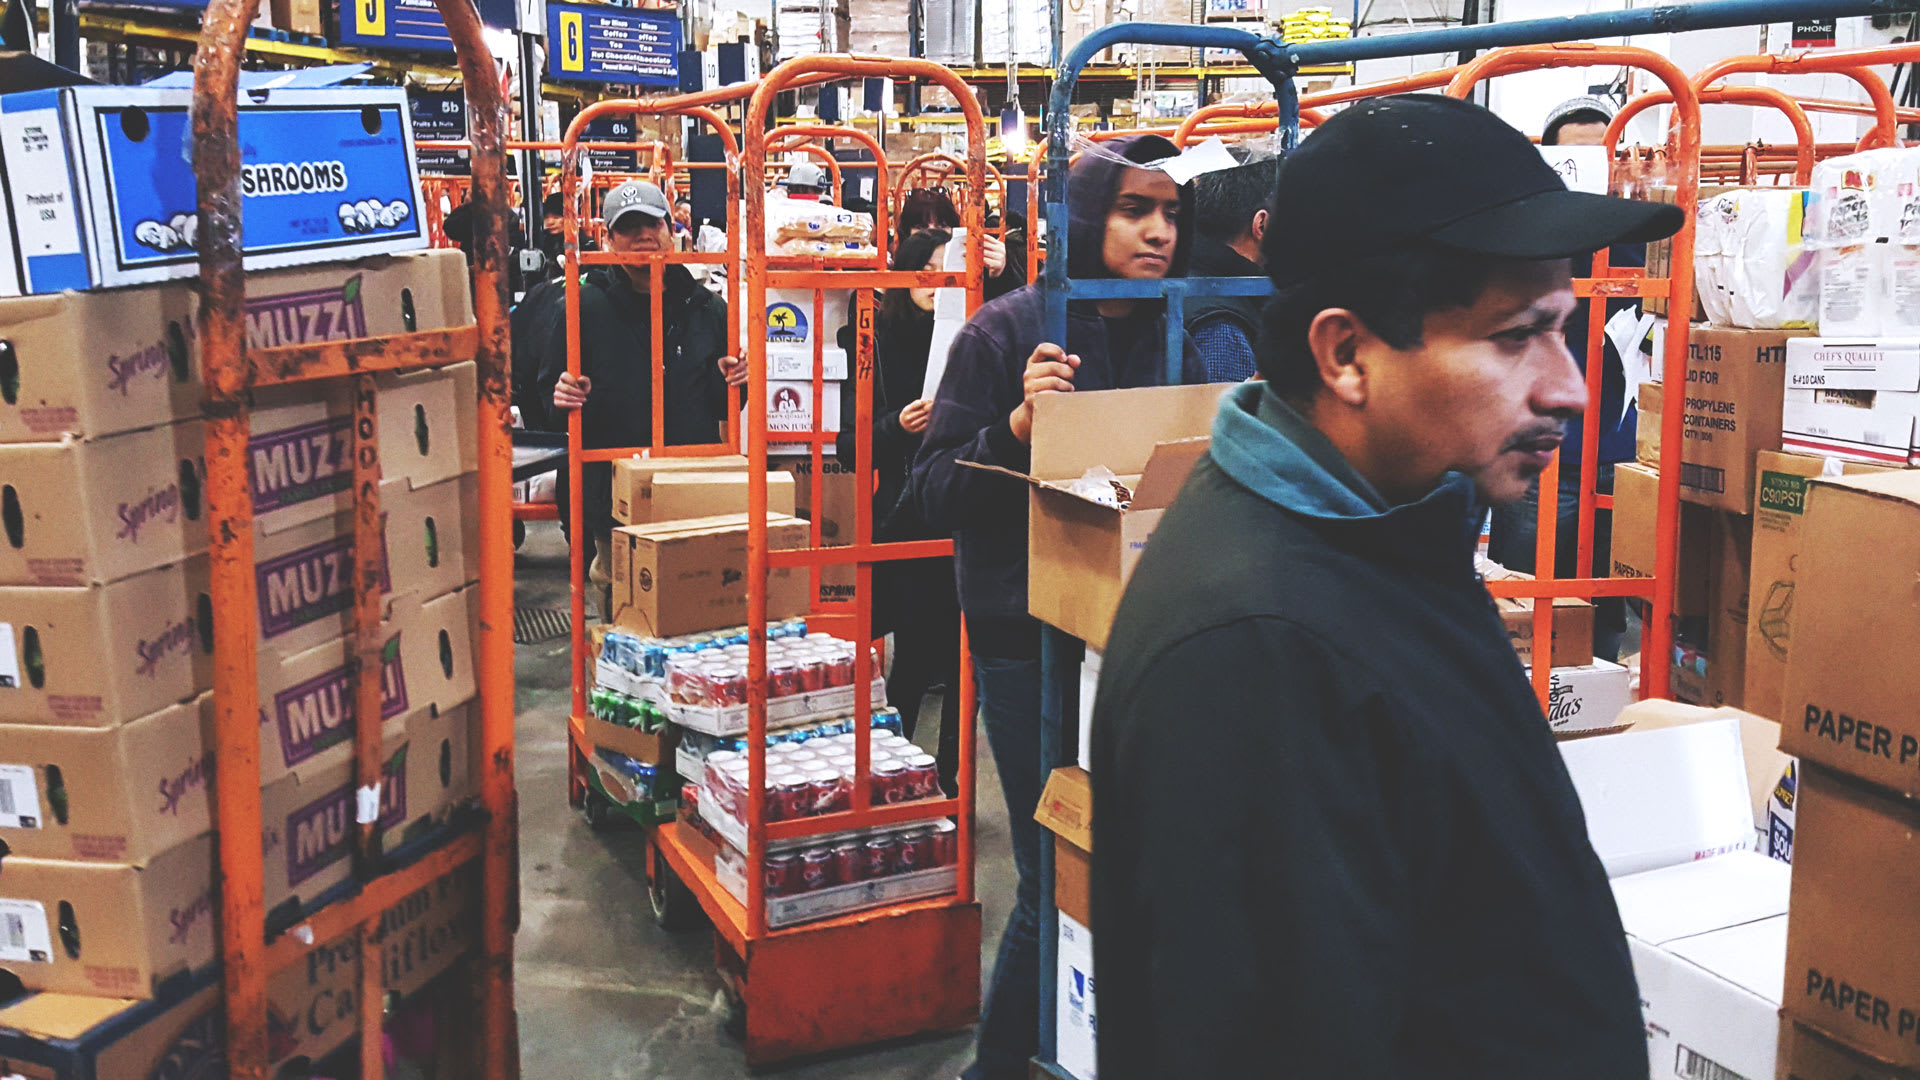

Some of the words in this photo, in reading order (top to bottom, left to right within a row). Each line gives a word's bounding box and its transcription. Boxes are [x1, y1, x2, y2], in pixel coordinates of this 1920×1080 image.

[603, 29, 628, 39] Coffee
[1797, 25, 1833, 33] PHONE
[568, 21, 578, 62] 6
[609, 41, 623, 49] Tea
[708, 63, 716, 79] 10
[612, 123, 628, 134] 6b
[242, 164, 344, 193] SHROOMS
[39, 208, 56, 221] USA
[246, 301, 356, 349] MUZZI
[1814, 352, 1842, 361] CHEF'S
[1845, 351, 1884, 365] QUALITY
[1700, 371, 1718, 384] FOR
[1810, 375, 1825, 385] CANS
[1686, 398, 1735, 415] PROPYLENE
[769, 423, 789, 431] MON
[1684, 414, 1736, 431] CONTAINERS
[254, 428, 352, 494] MUZZ
[1762, 487, 1801, 508] C90PST
[267, 553, 340, 617] MUZ
[1549, 697, 1582, 721] da's
[1804, 704, 1892, 759] PAPER
[1806, 968, 1890, 1032] PAPER
